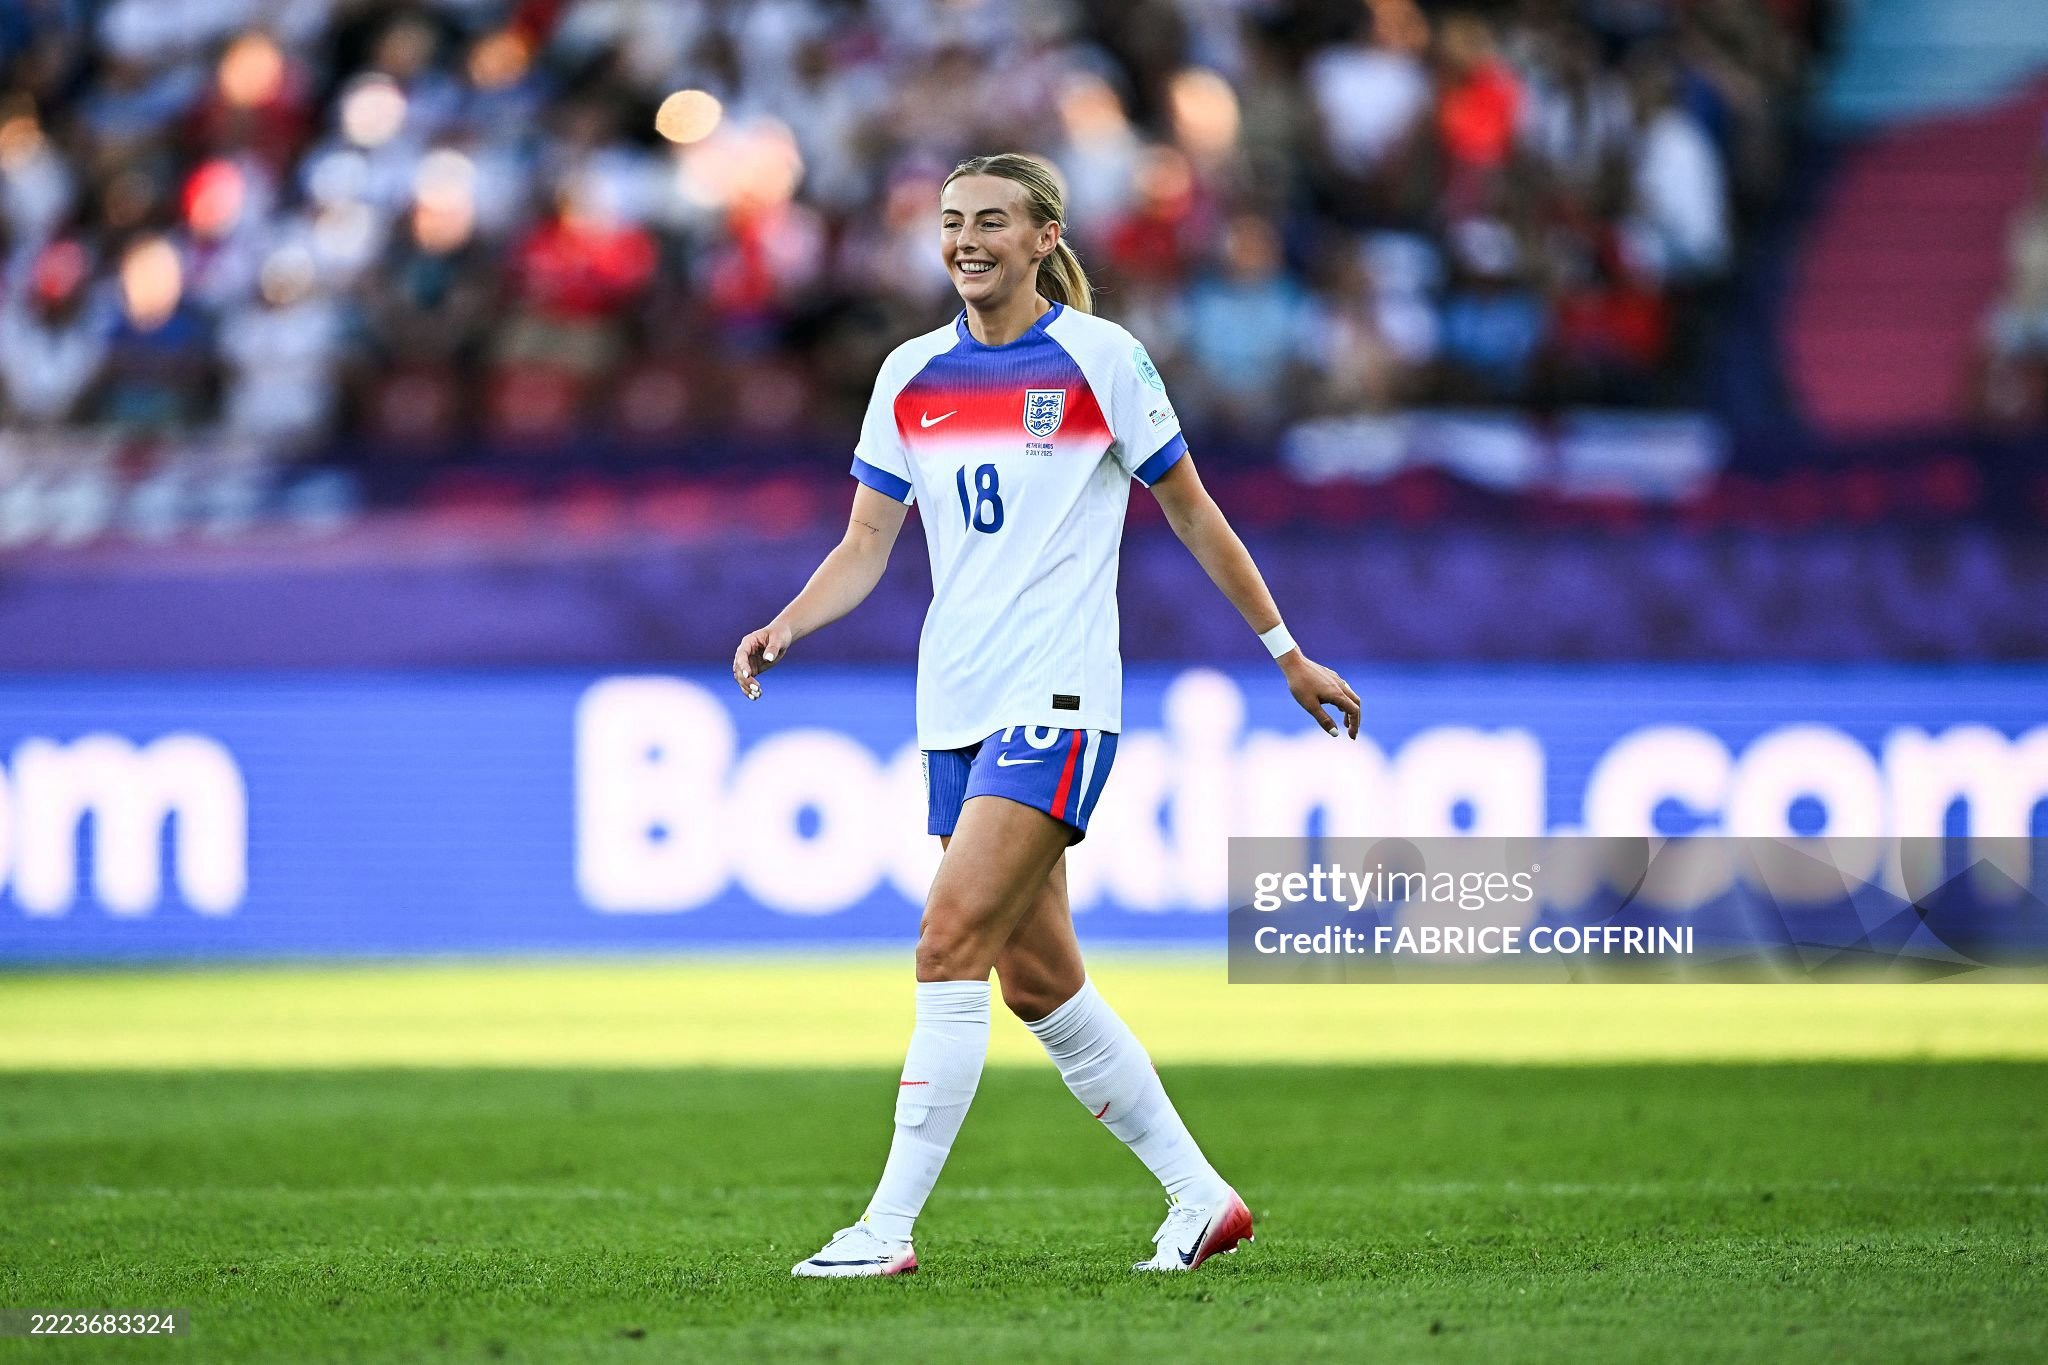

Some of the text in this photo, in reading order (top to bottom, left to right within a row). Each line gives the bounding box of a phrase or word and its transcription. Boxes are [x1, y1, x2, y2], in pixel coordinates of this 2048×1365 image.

[1025, 442, 1054, 450] NETHERLANDS
[1030, 449, 1040, 457] JULY
[956, 463, 1005, 535] 18
[0, 732, 249, 918] m
